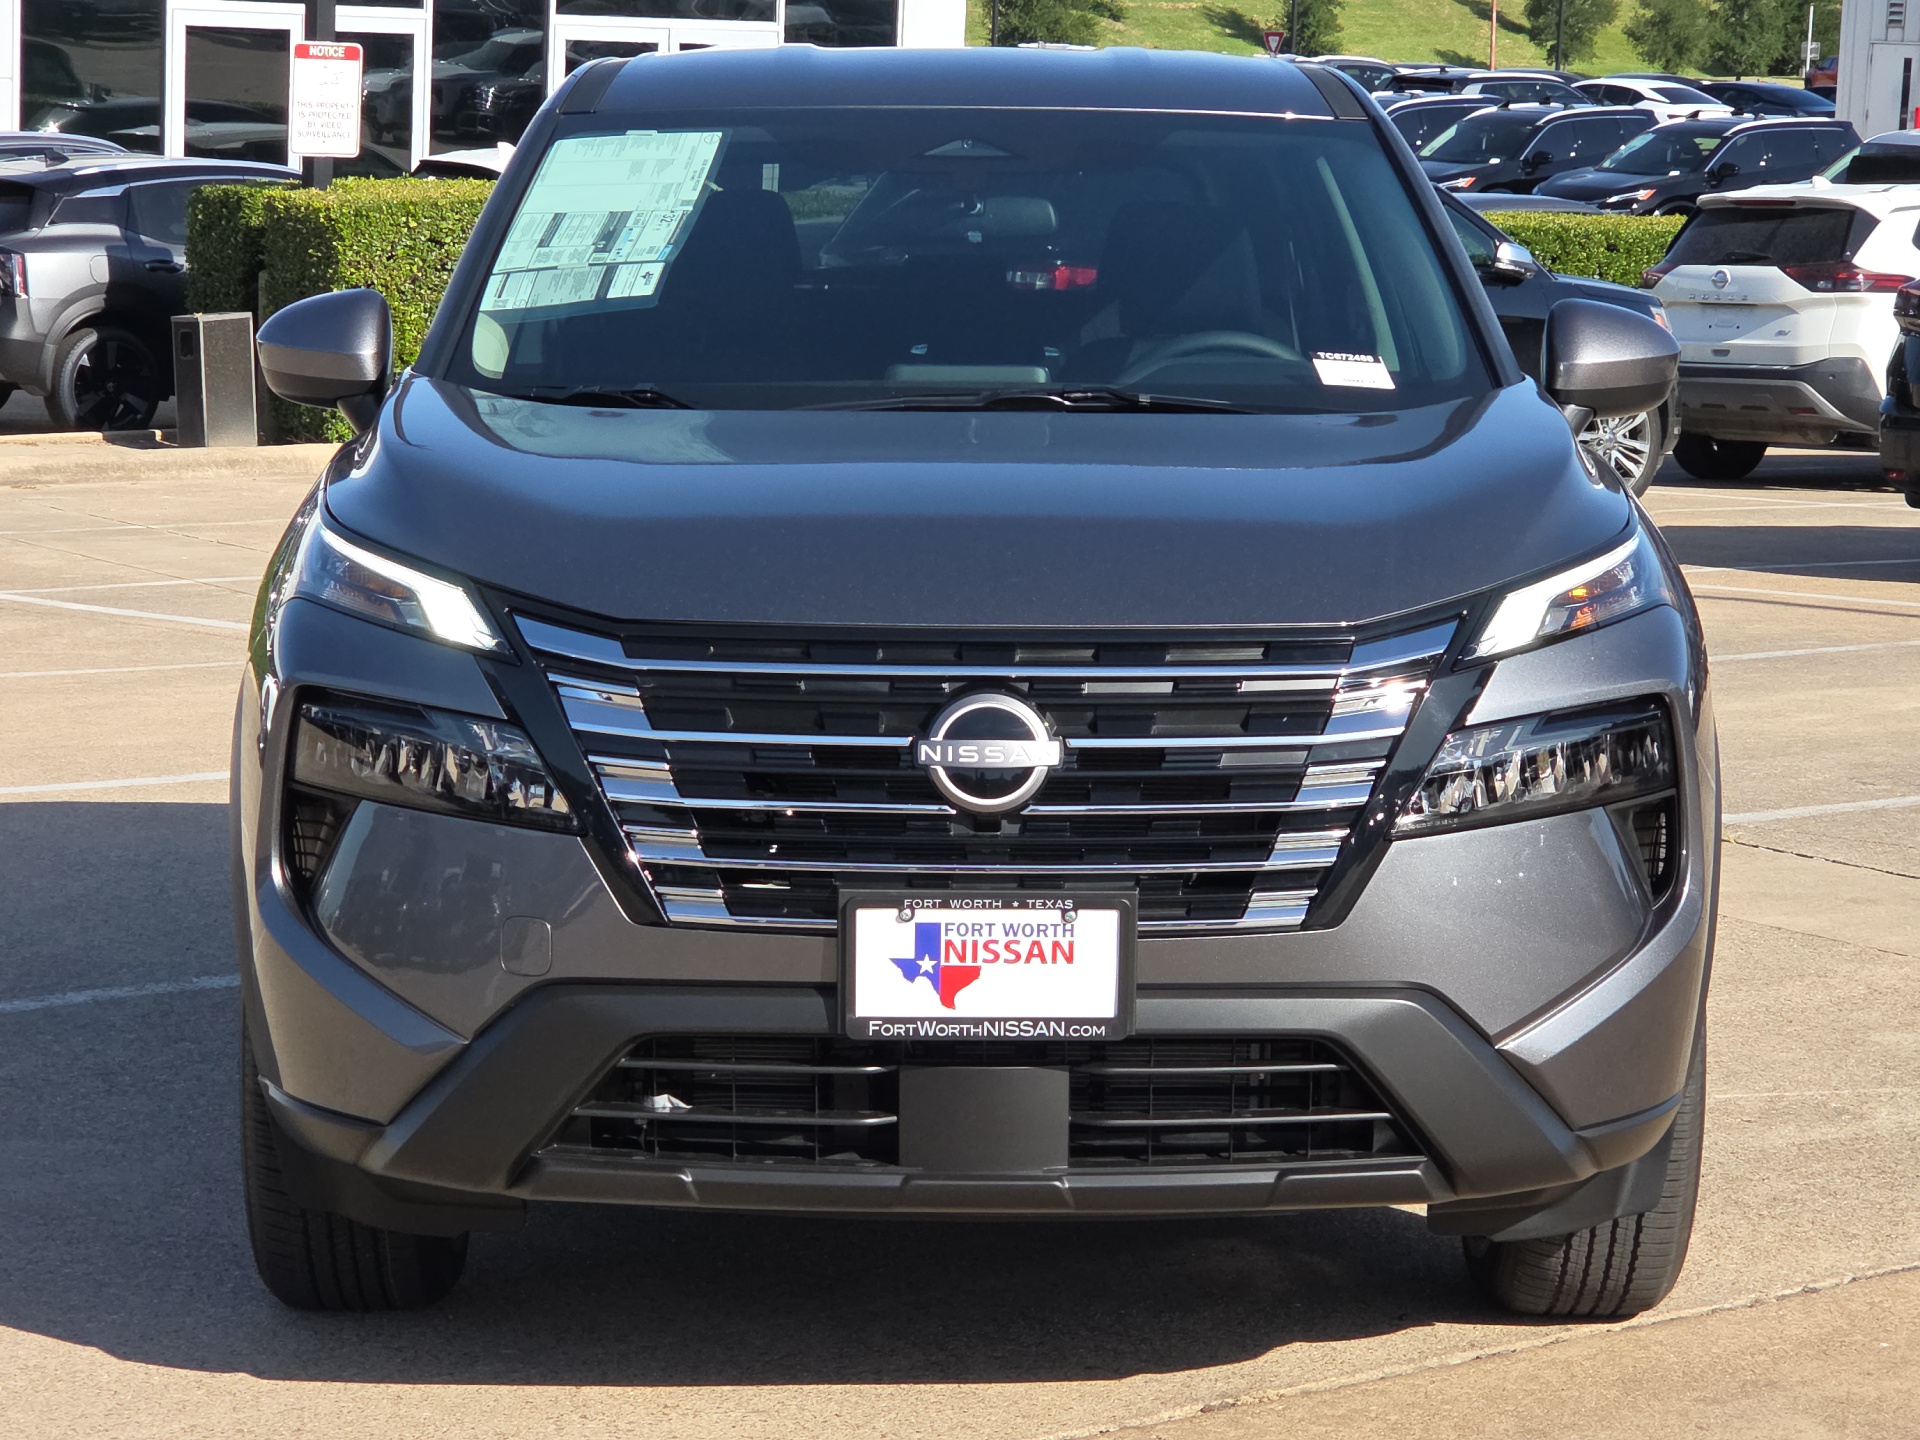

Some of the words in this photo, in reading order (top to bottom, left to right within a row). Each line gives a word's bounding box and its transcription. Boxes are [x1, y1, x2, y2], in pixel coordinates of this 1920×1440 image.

[309, 45, 346, 57] NOTICE
[297, 101, 313, 109] THIS
[298, 111, 306, 119] IS
[308, 111, 352, 120] PROTECTED
[307, 120, 316, 128] BY
[320, 121, 342, 129] VIDEO
[297, 130, 352, 139] SURVEILLANCE
[920, 744, 1056, 763] NISSA
[904, 899, 942, 909] FORT
[950, 899, 1002, 909] WORTH
[1026, 899, 1074, 909] TEXAS
[944, 922, 996, 937] FORT
[1002, 923, 1075, 938] WORTH
[944, 939, 1075, 964] NISSAN
